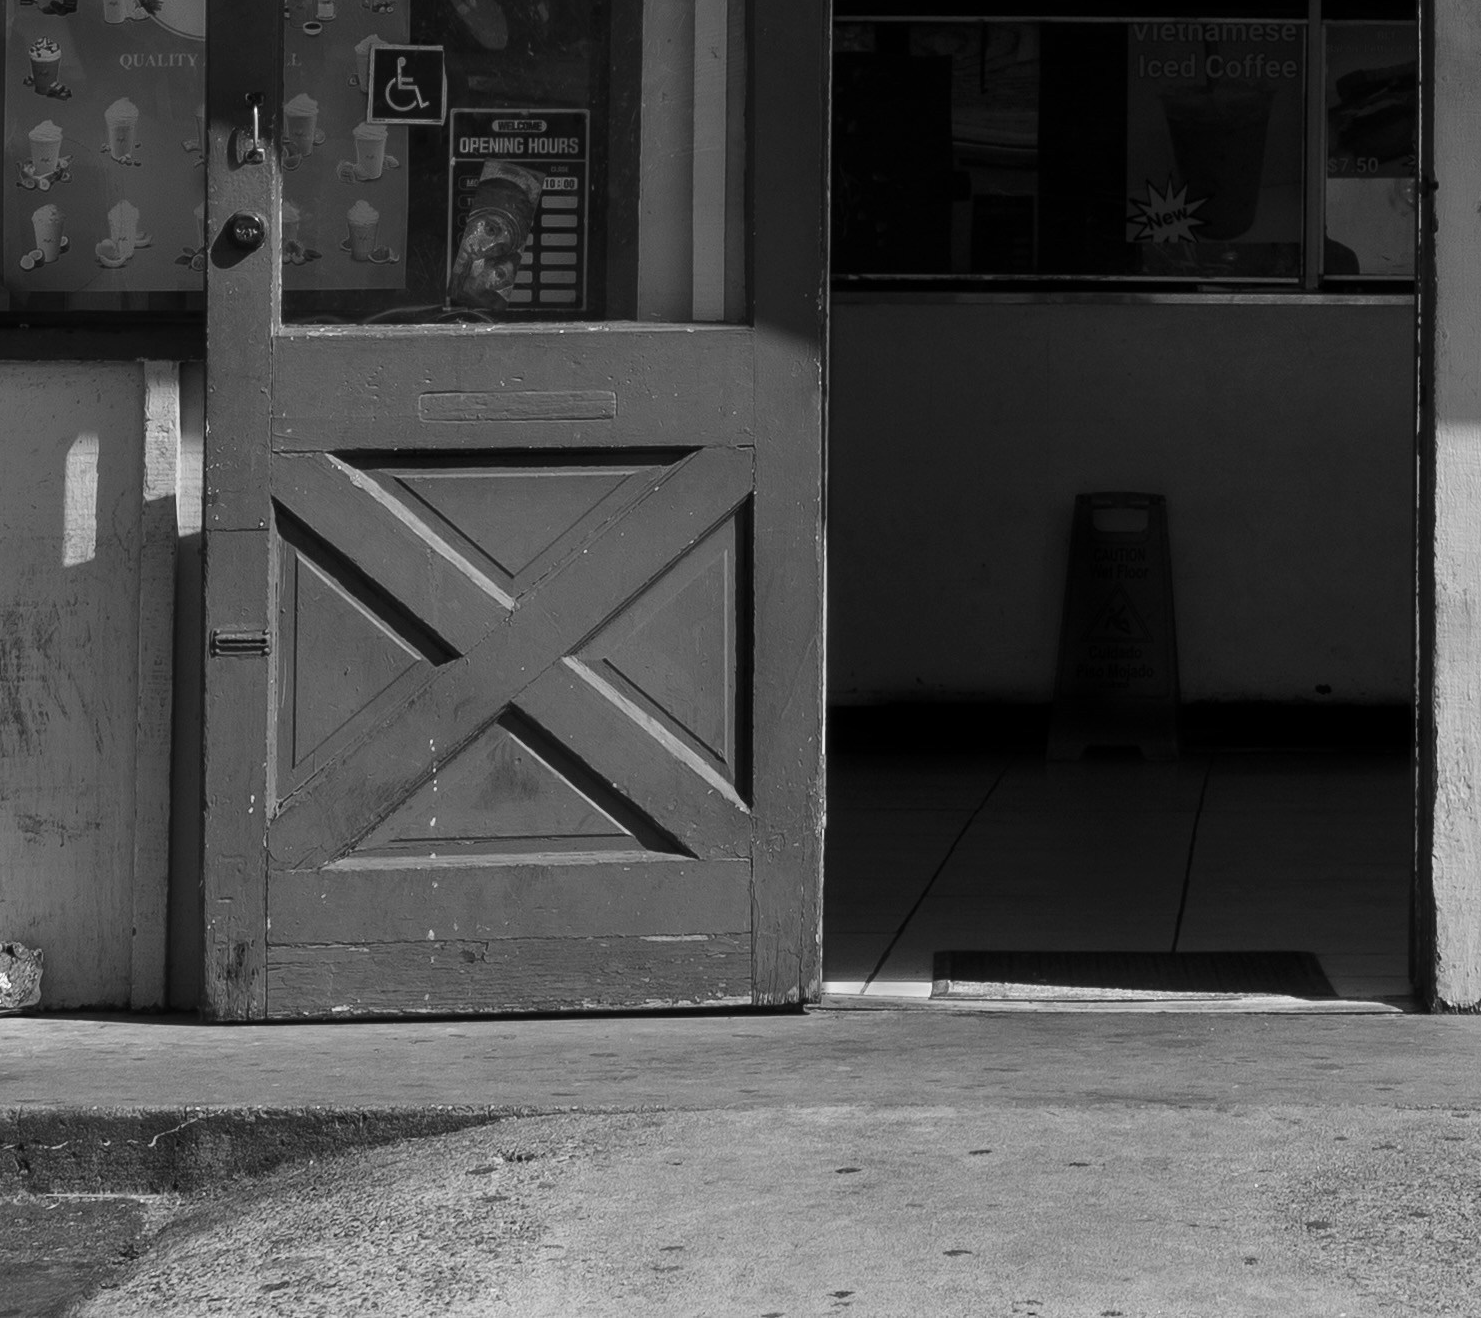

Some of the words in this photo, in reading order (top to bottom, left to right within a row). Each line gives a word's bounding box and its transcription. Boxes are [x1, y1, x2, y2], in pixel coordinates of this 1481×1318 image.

[1133, 23, 1299, 44] Vietnamese
[119, 53, 199, 70] QUALITY
[1138, 54, 1197, 79] Iced
[1204, 54, 1299, 79] Coffee
[497, 121, 542, 131] WELCOME
[459, 137, 524, 154] OPENING
[527, 137, 580, 154] HOURS
[1327, 157, 1380, 176] $7.50
[544, 178, 576, 190] 10:00
[1147, 205, 1191, 230] New
[1092, 547, 1146, 564] CAUTION
